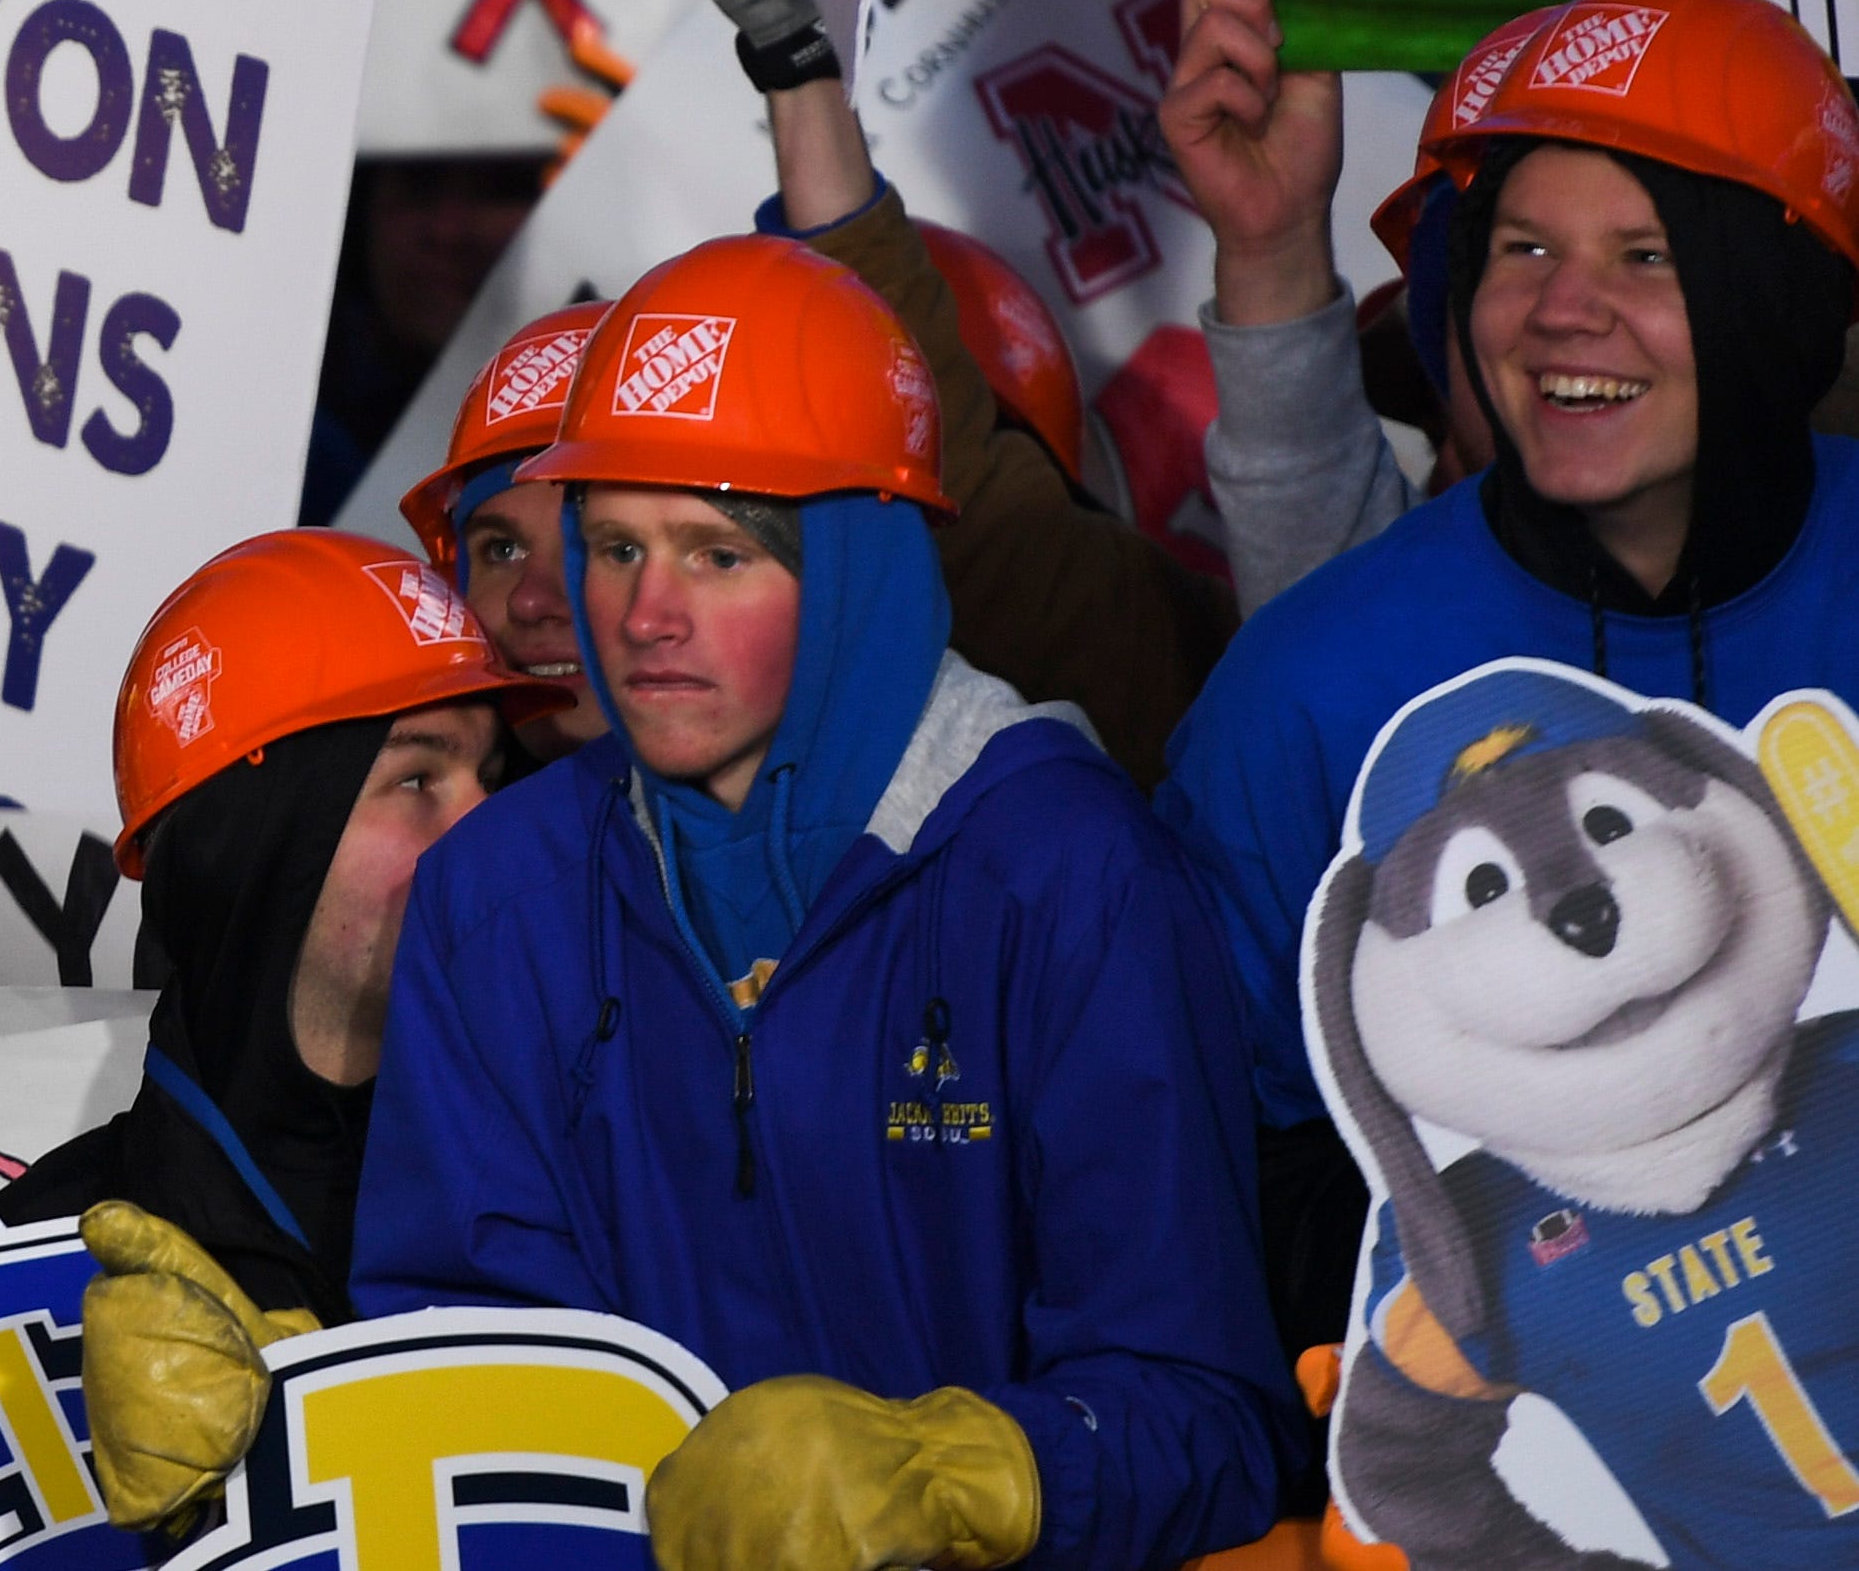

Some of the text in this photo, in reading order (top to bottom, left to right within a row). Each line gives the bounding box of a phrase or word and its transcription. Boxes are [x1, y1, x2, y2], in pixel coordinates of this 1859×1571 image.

[1537, 7, 1660, 86] HOME
[1561, 11, 1606, 42] THE
[1568, 37, 1645, 87] DEPOT
[501, 344, 541, 378] THE
[617, 317, 729, 413] HOME
[633, 325, 678, 365] THE
[650, 352, 720, 414] DEPOT
[150, 651, 213, 706] GAMEDAY
[1620, 1215, 1776, 1328] STATE
[1697, 1309, 1859, 1521] 1
